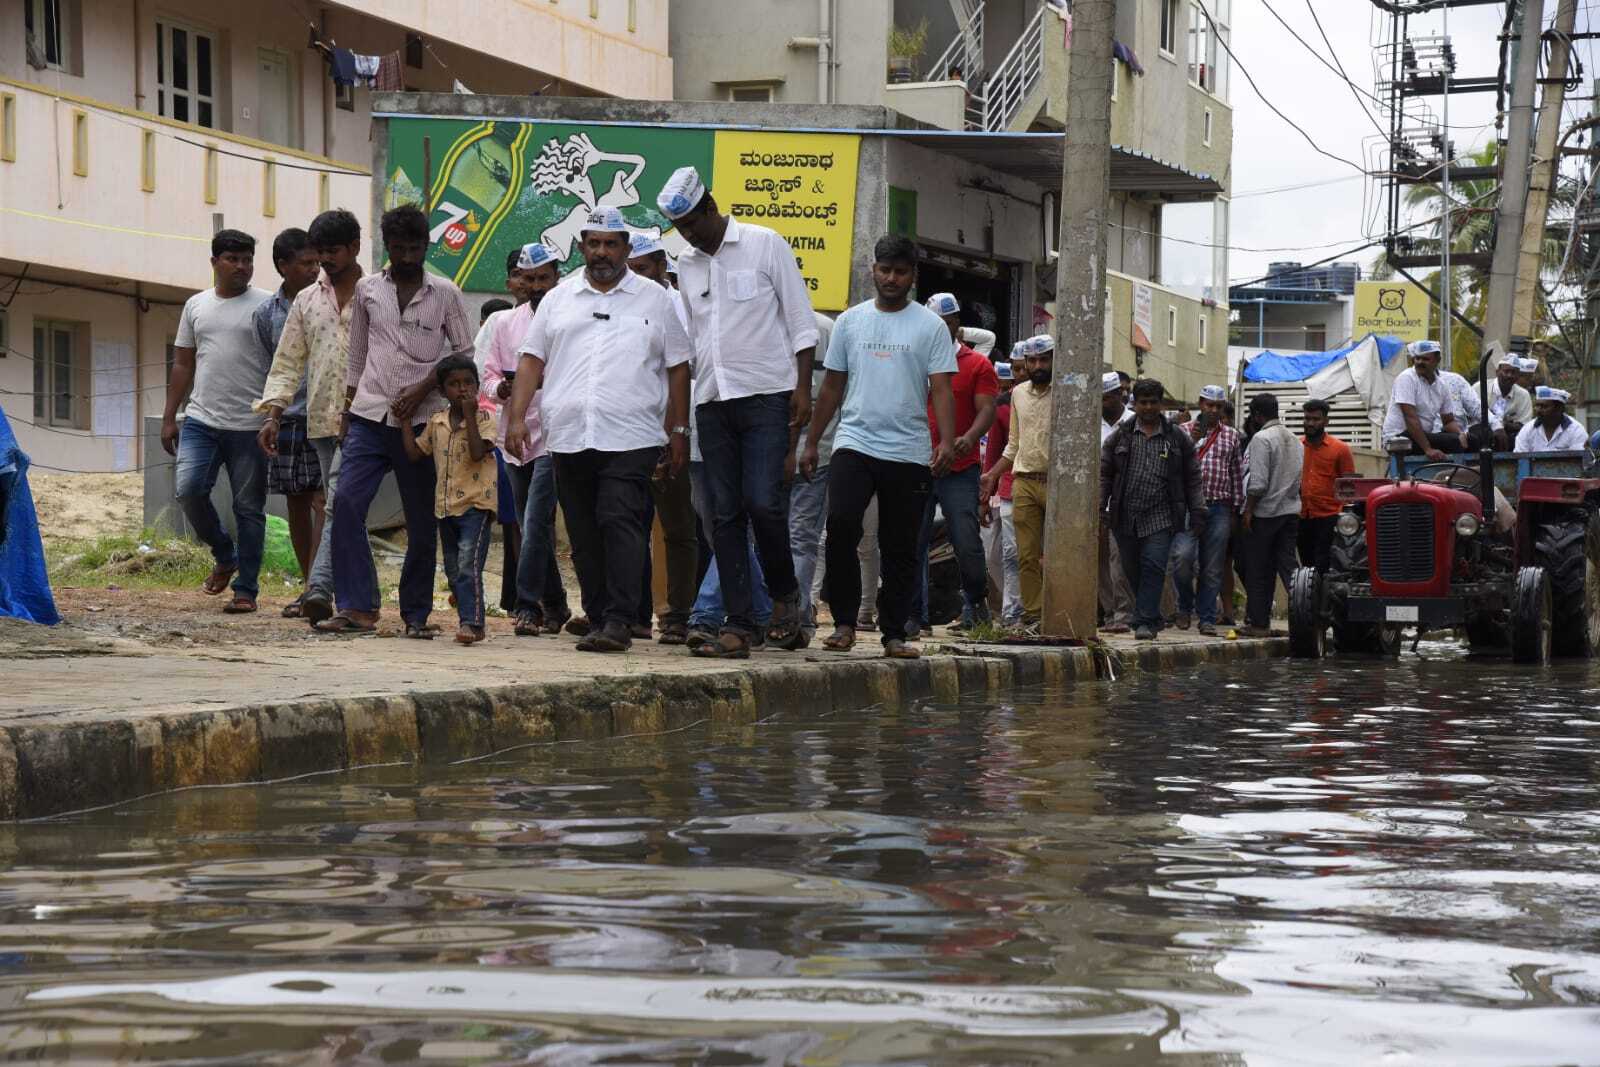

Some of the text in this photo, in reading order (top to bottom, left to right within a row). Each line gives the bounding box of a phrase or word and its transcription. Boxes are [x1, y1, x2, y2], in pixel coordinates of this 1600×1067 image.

[739, 151, 834, 171] ಮಂಜುನಾಥ
[812, 179, 824, 193] &
[783, 236, 826, 250] ATHA
[1358, 316, 1422, 327] Bear Basket
